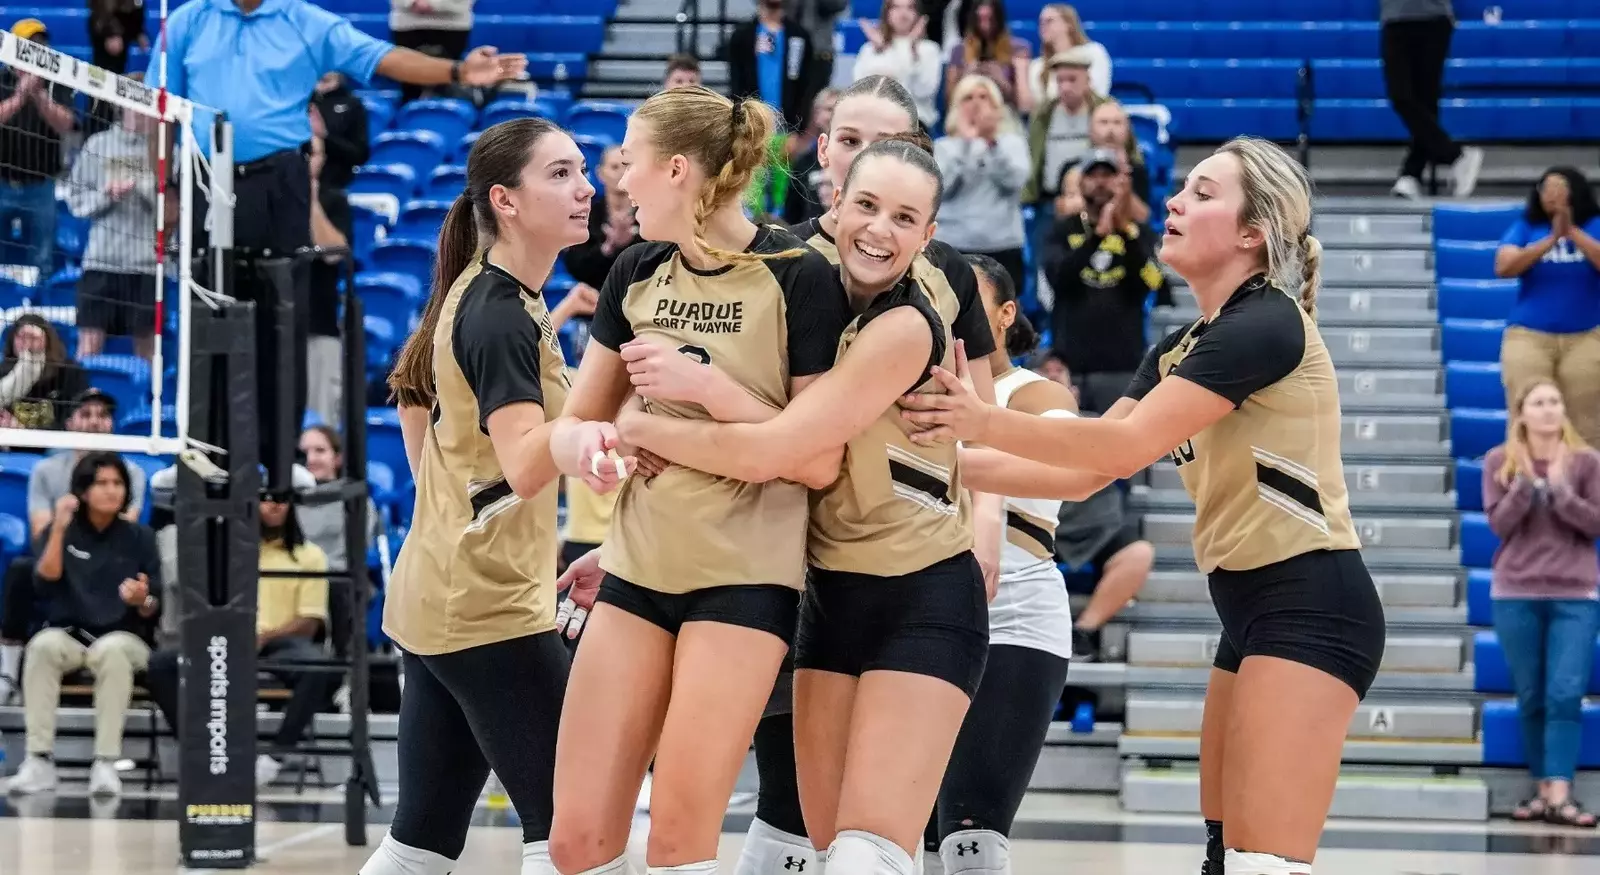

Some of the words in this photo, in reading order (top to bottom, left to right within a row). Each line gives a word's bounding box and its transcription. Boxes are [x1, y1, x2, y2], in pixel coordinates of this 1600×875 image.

[655, 299, 743, 320] PURDUE
[653, 317, 690, 330] FORT
[693, 321, 742, 333] WAYNE
[207, 635, 230, 698] sports
[1373, 710, 1388, 729] A
[206, 699, 229, 775] imports
